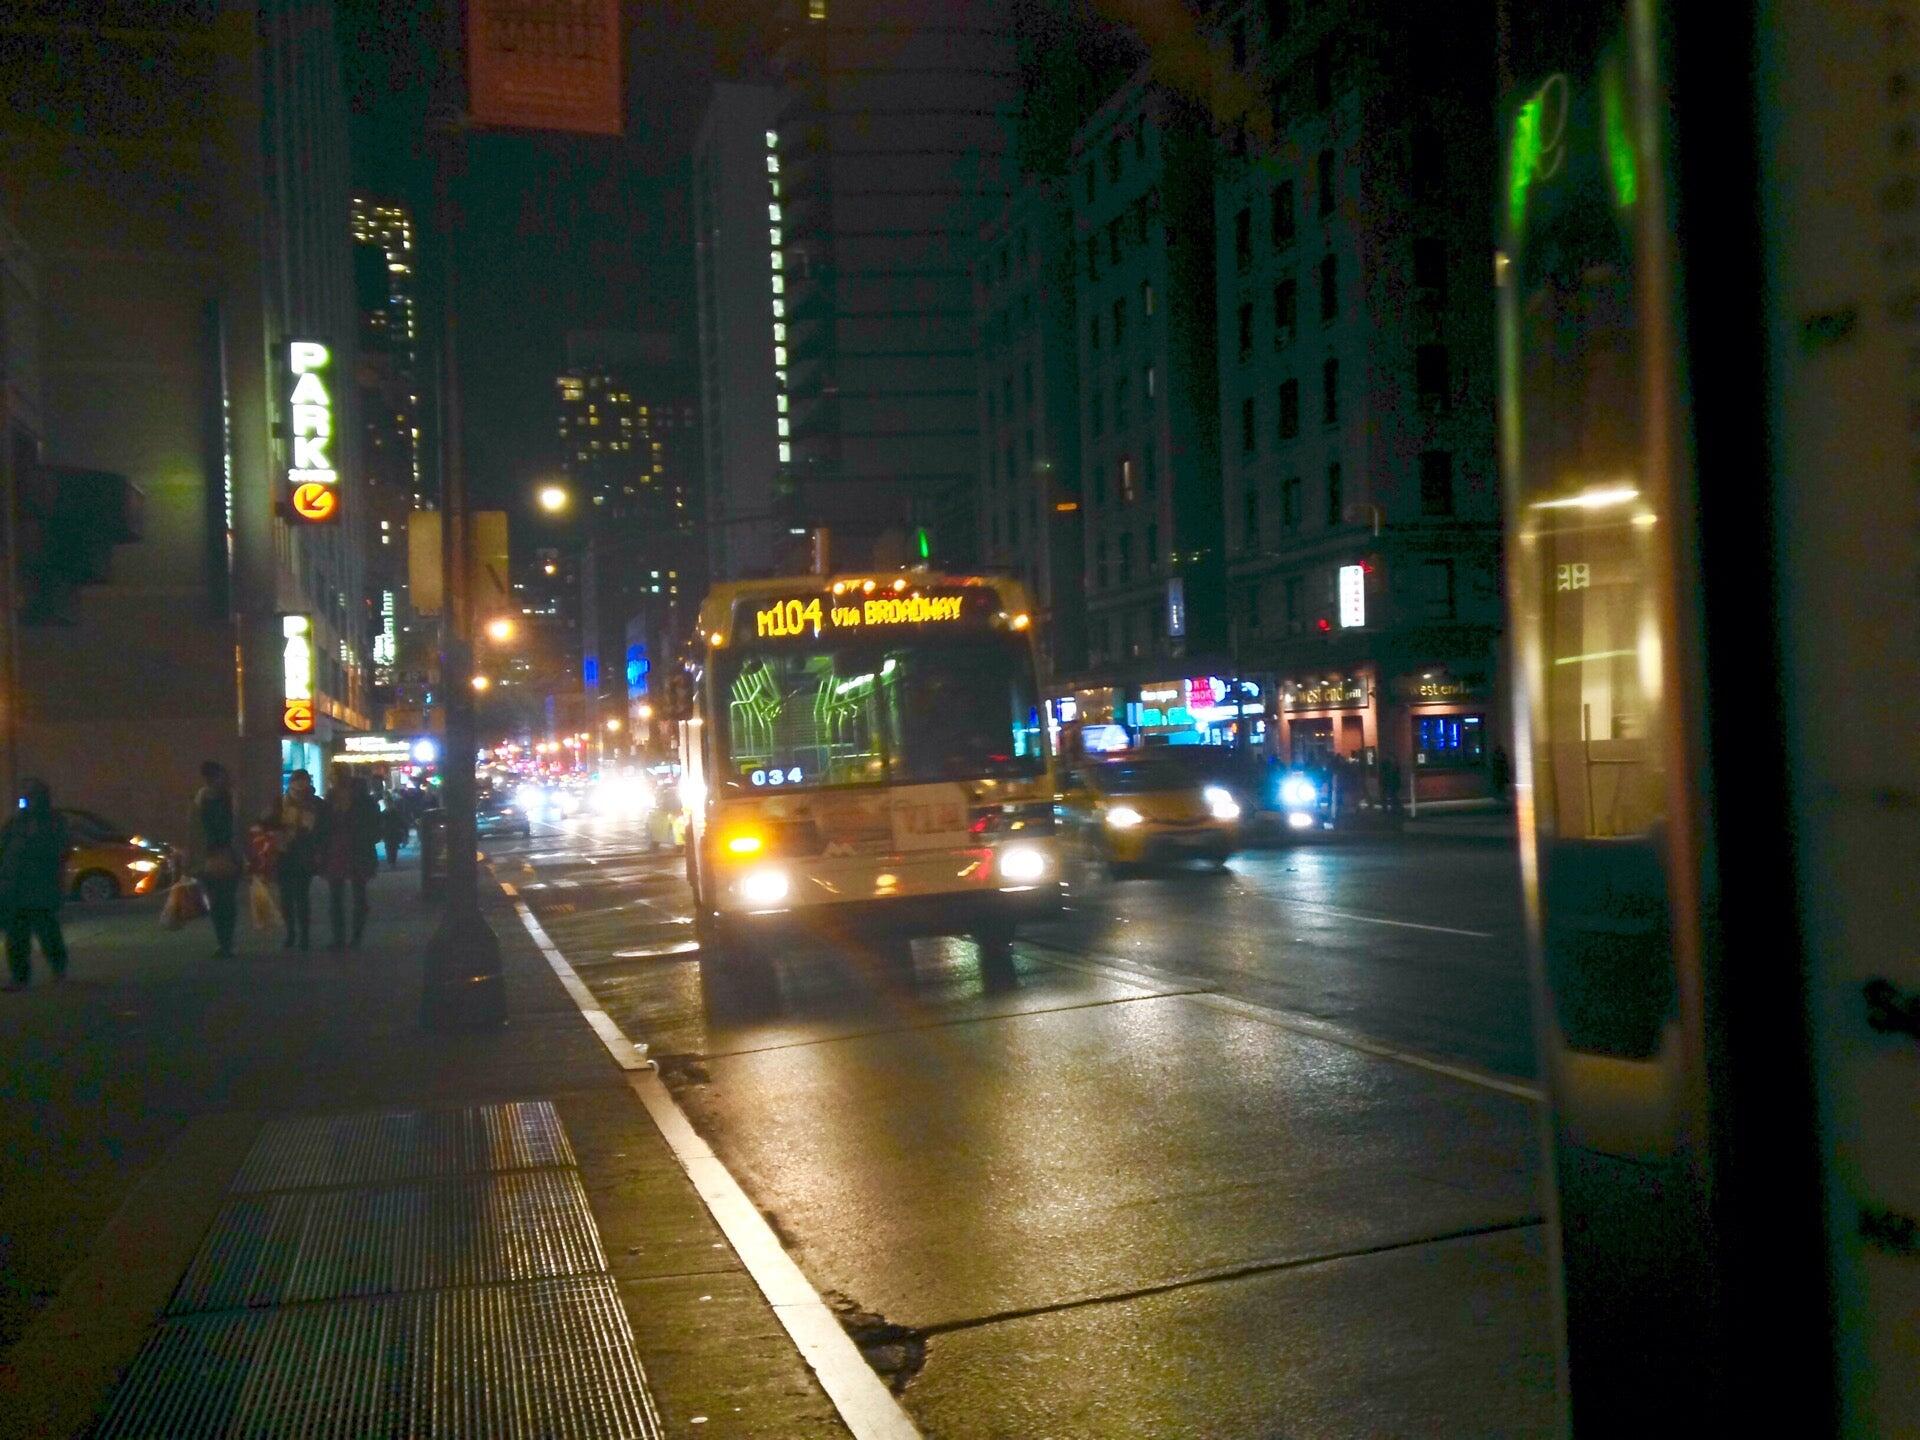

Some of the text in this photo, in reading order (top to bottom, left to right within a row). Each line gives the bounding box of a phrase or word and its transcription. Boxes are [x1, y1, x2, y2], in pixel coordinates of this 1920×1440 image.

[290, 341, 331, 469] PARK
[757, 598, 823, 637] M104
[864, 596, 963, 625] BROADWAY
[751, 766, 803, 786] 034
